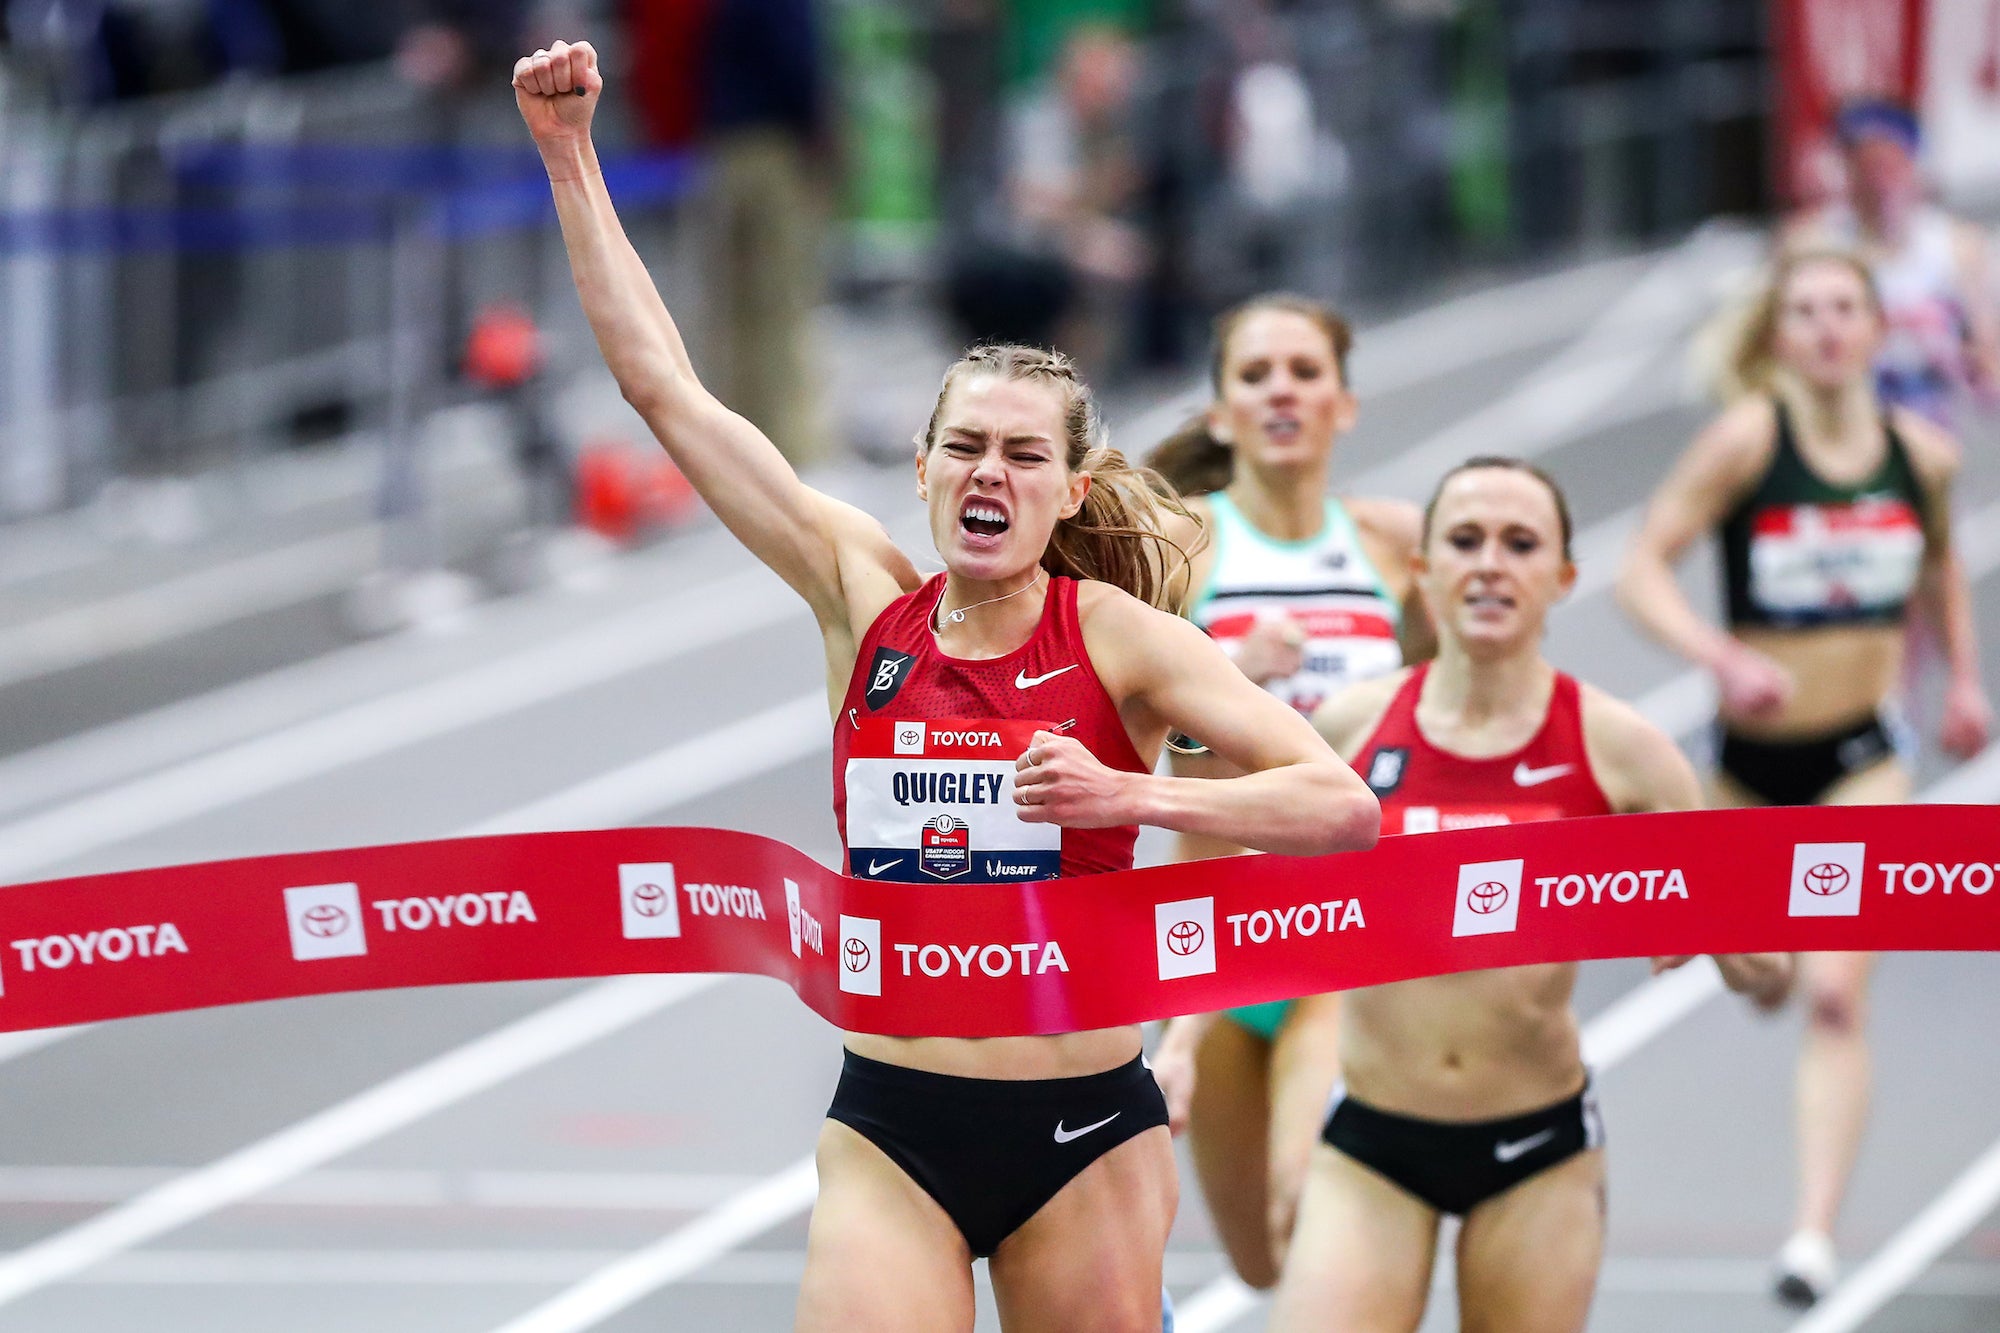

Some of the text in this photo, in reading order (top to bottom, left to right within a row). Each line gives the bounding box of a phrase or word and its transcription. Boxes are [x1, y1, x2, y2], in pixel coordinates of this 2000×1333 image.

[931, 731, 1002, 747] TOYOTA
[893, 771, 1004, 806] QUIGLEY
[1001, 865, 1037, 876] USATF
[1534, 868, 1689, 908] TOYOTA
[372, 890, 537, 932] TOYOTA
[682, 883, 767, 921] TOYOTA
[1226, 898, 1366, 947] TOYOTA
[10, 922, 189, 972] TOYOTA
[893, 941, 1070, 978] TOYOTA
